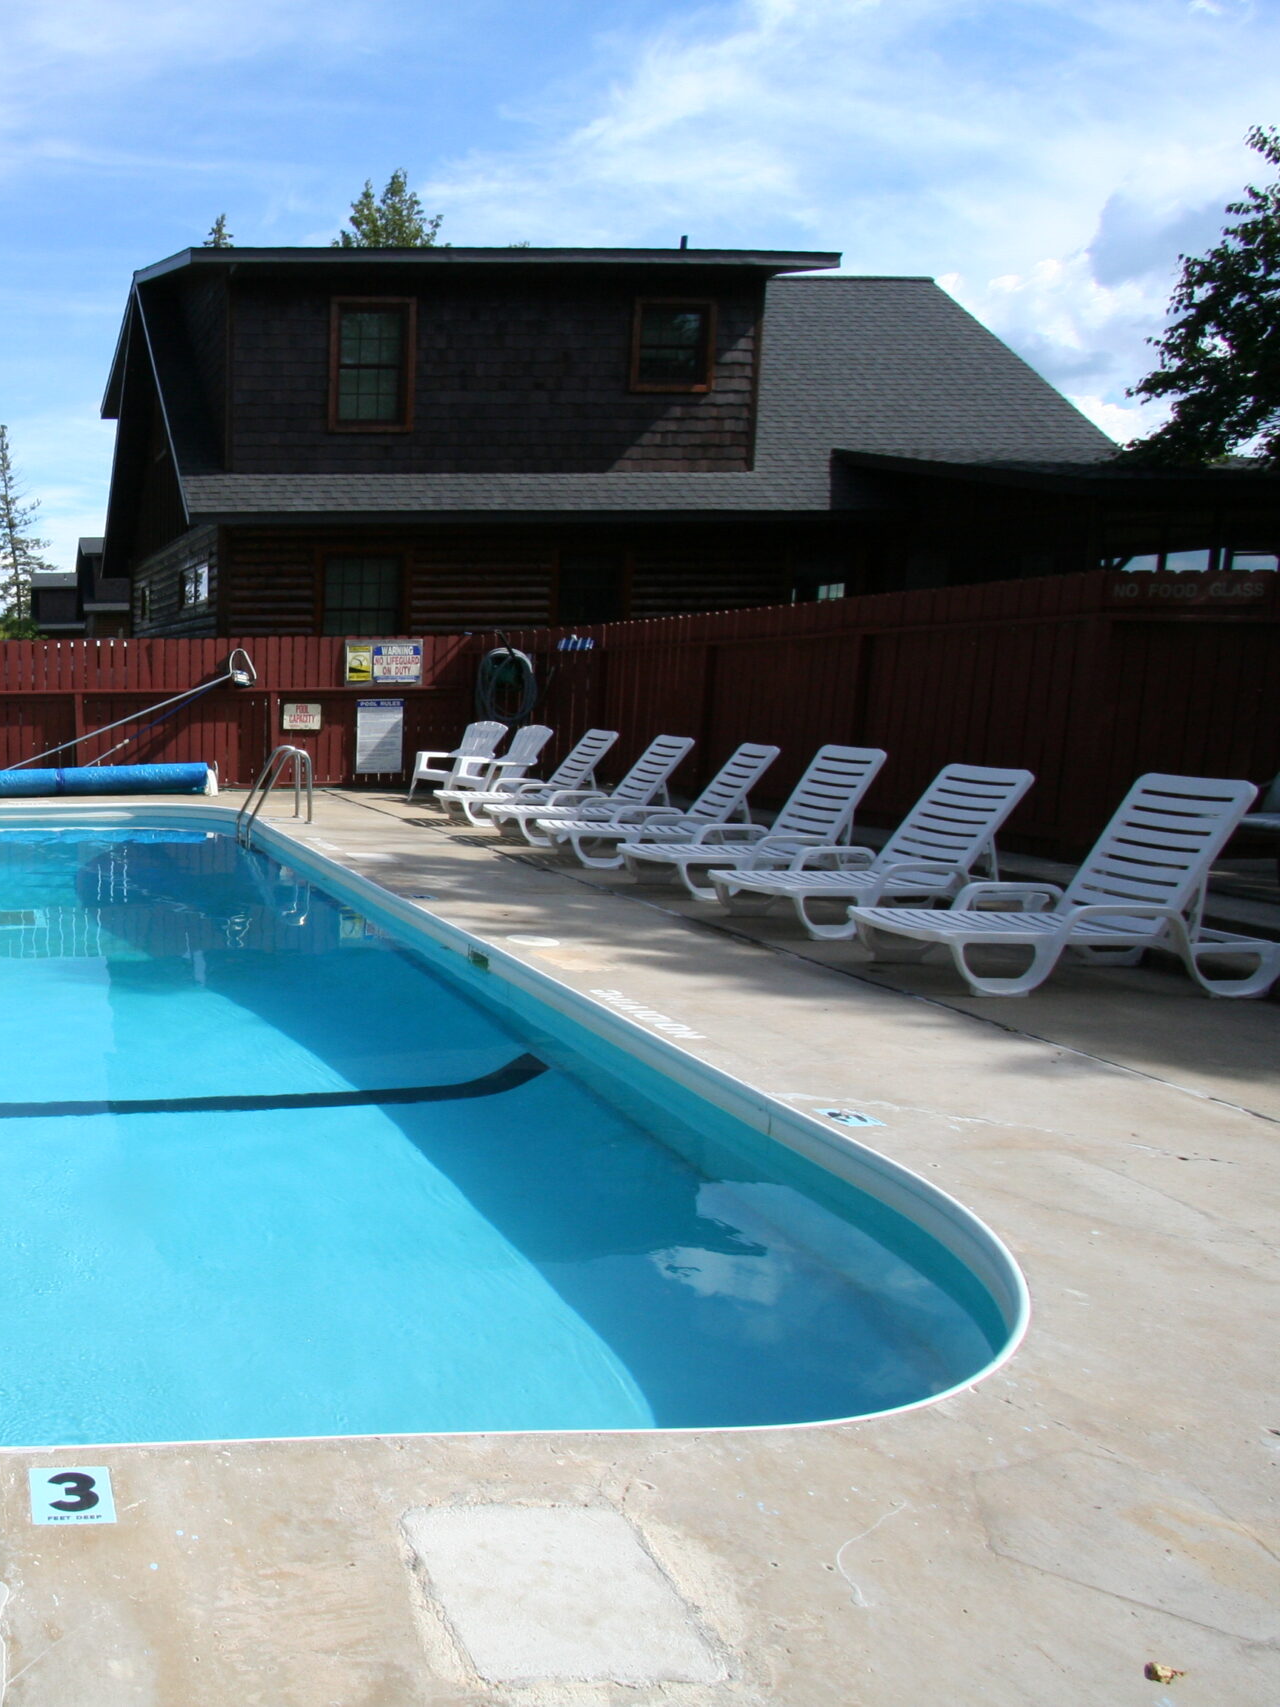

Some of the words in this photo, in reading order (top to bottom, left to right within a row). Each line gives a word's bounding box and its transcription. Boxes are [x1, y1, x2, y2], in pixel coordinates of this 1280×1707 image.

[1113, 583, 1139, 598] NO
[1148, 583, 1198, 598] FOOD
[1210, 582, 1265, 598] GLASS
[381, 646, 413, 655] WARNING
[375, 656, 384, 665] NO
[386, 656, 420, 665] LIFEGUARD
[383, 666, 391, 675] ON
[395, 666, 411, 675] DUTY
[295, 704, 309, 713] POOL
[288, 714, 316, 723] CAPACITY
[47, 1472, 100, 1512] 3
